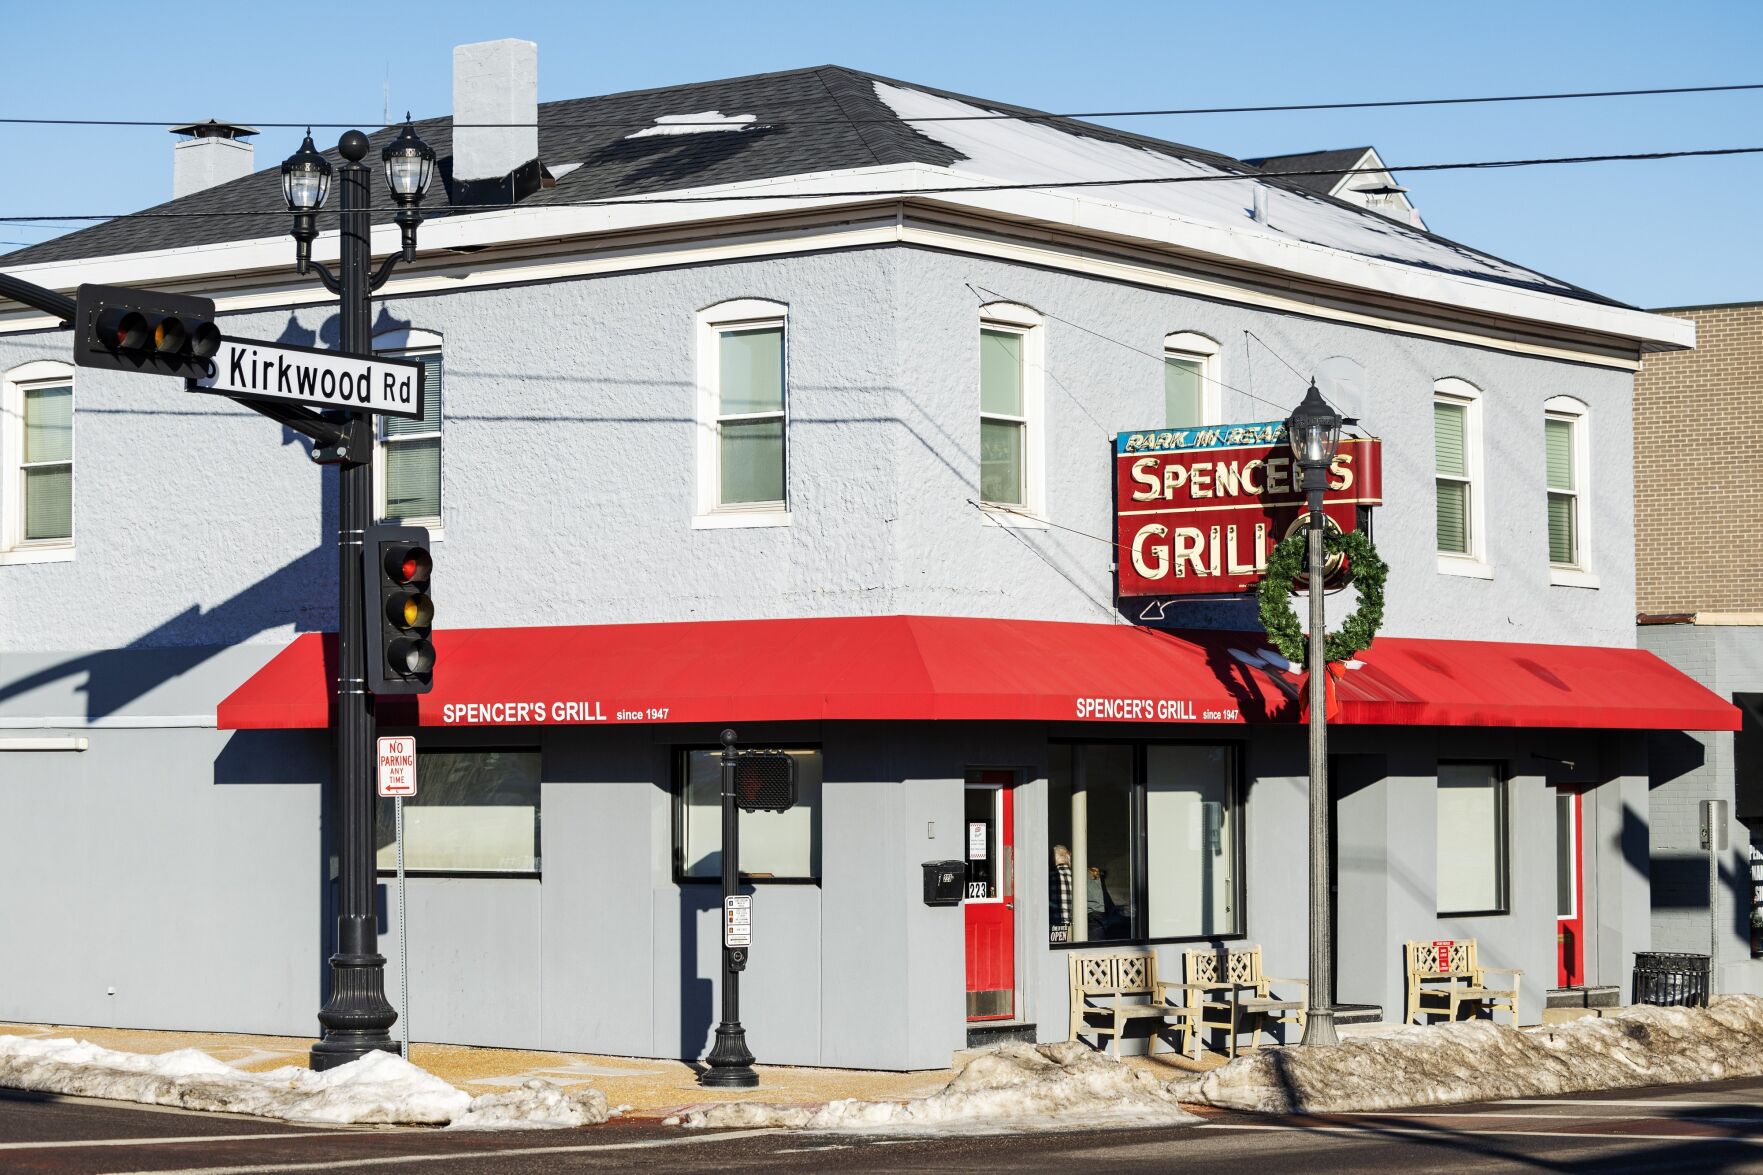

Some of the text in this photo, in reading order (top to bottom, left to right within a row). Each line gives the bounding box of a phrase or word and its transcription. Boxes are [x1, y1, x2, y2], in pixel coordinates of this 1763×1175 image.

[230, 347, 371, 403] Kirkwood
[383, 372, 411, 404] Rd
[1125, 431, 1189, 452] PARK
[1131, 453, 1354, 501] SPENCES
[1131, 523, 1269, 580] GRILL
[443, 702, 669, 723] SPENCER'S GRILL since 1947
[1076, 697, 1239, 720] SPENCER'S GRILL since 1947
[389, 742, 403, 754] NO
[380, 755, 413, 767] PARKING
[389, 776, 405, 784] TIME
[390, 767, 404, 775] ANY
[969, 883, 986, 898] 223
[1050, 931, 1067, 942] OPEN
